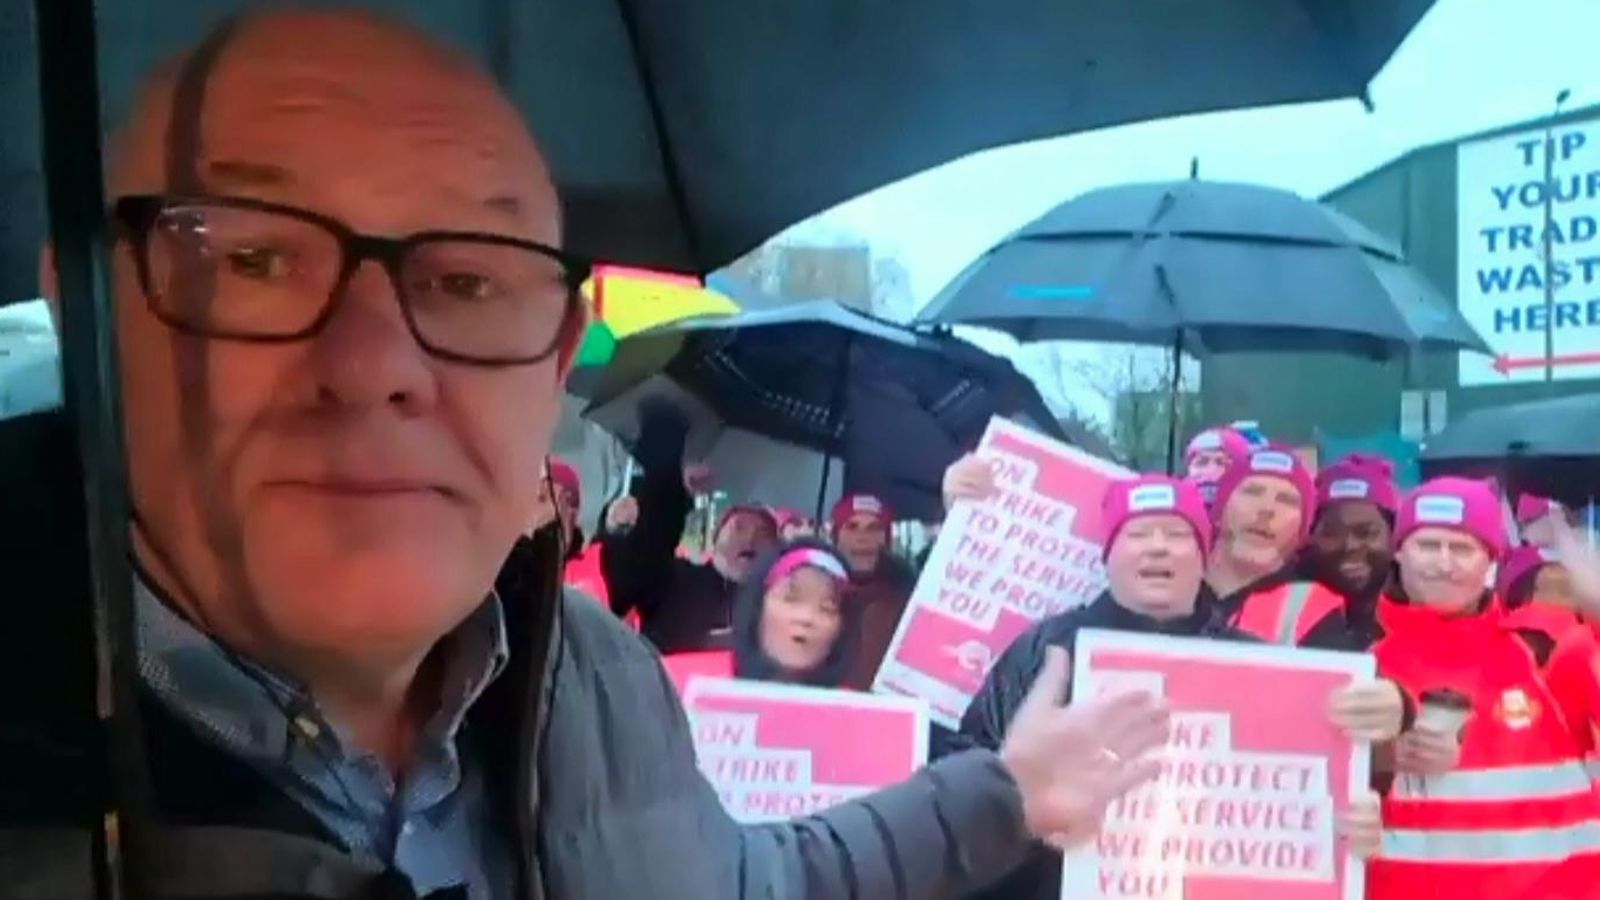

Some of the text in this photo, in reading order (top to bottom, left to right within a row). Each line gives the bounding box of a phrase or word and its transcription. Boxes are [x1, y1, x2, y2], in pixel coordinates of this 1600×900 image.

[1516, 131, 1586, 166] TIP
[1491, 171, 1600, 210] YOUR
[1480, 216, 1598, 252] TRAD
[1477, 256, 1600, 293] WAST
[1494, 300, 1600, 333] HERE
[989, 457, 1029, 485] ON
[966, 507, 1102, 574] TO PROTEC
[945, 559, 985, 590] WE
[957, 533, 1102, 599] THE SERVIC
[939, 587, 992, 621] YOU
[716, 757, 799, 784] TRIKE
[1174, 797, 1317, 831] SERVICE
[1097, 832, 1319, 871] WE PROVIDE
[1098, 866, 1168, 898] YOU
